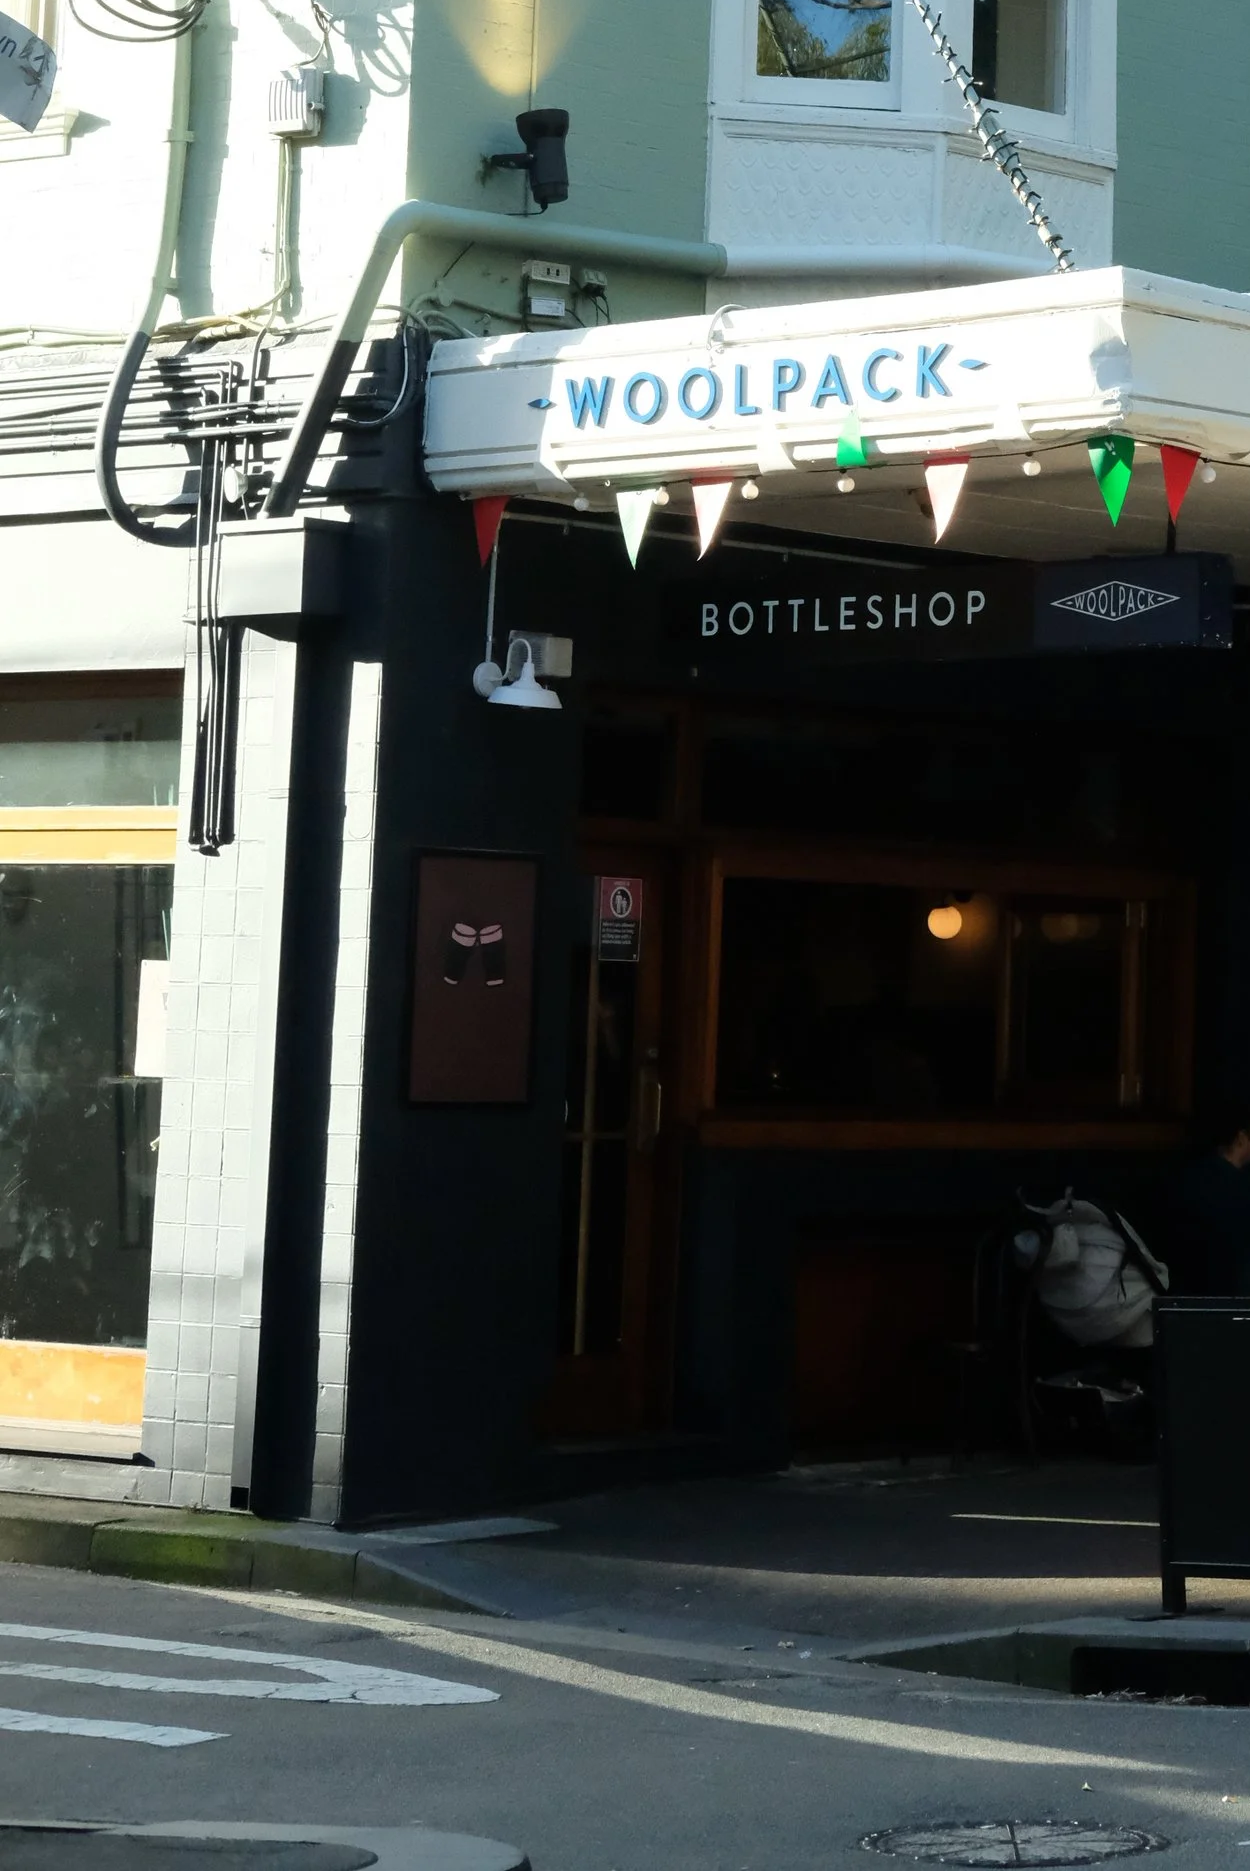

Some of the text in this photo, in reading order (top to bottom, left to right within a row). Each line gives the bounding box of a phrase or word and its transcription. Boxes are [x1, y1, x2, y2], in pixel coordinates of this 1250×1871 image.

[565, 342, 953, 430] WOOLPACK
[701, 589, 986, 637] BOTTLESHOP
[1074, 584, 1155, 617] WOOLPACK
